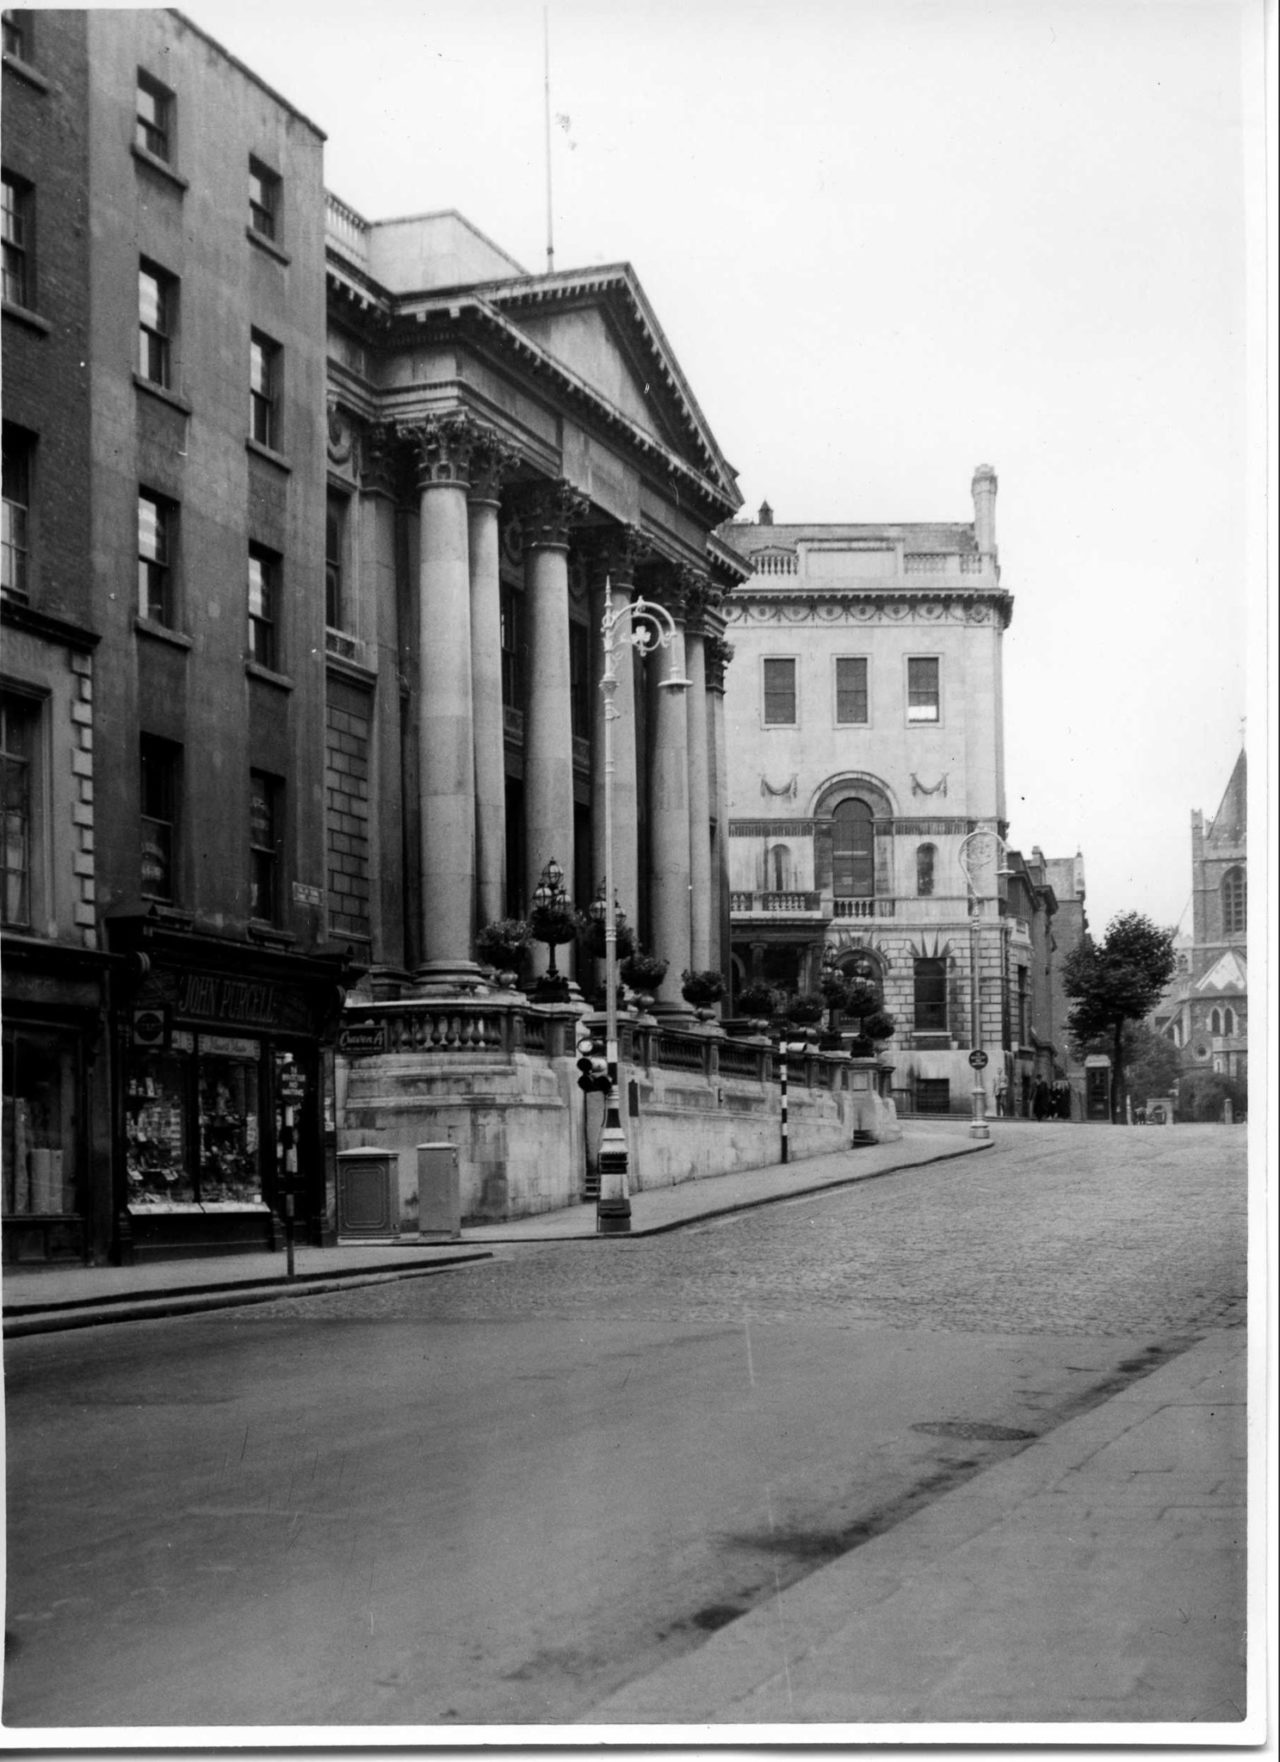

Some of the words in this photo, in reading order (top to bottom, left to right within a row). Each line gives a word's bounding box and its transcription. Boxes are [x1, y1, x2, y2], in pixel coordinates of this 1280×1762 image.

[178, 975, 217, 1015] JOHN
[219, 981, 276, 1023] PURCELL
[339, 1030, 373, 1047] Craven
